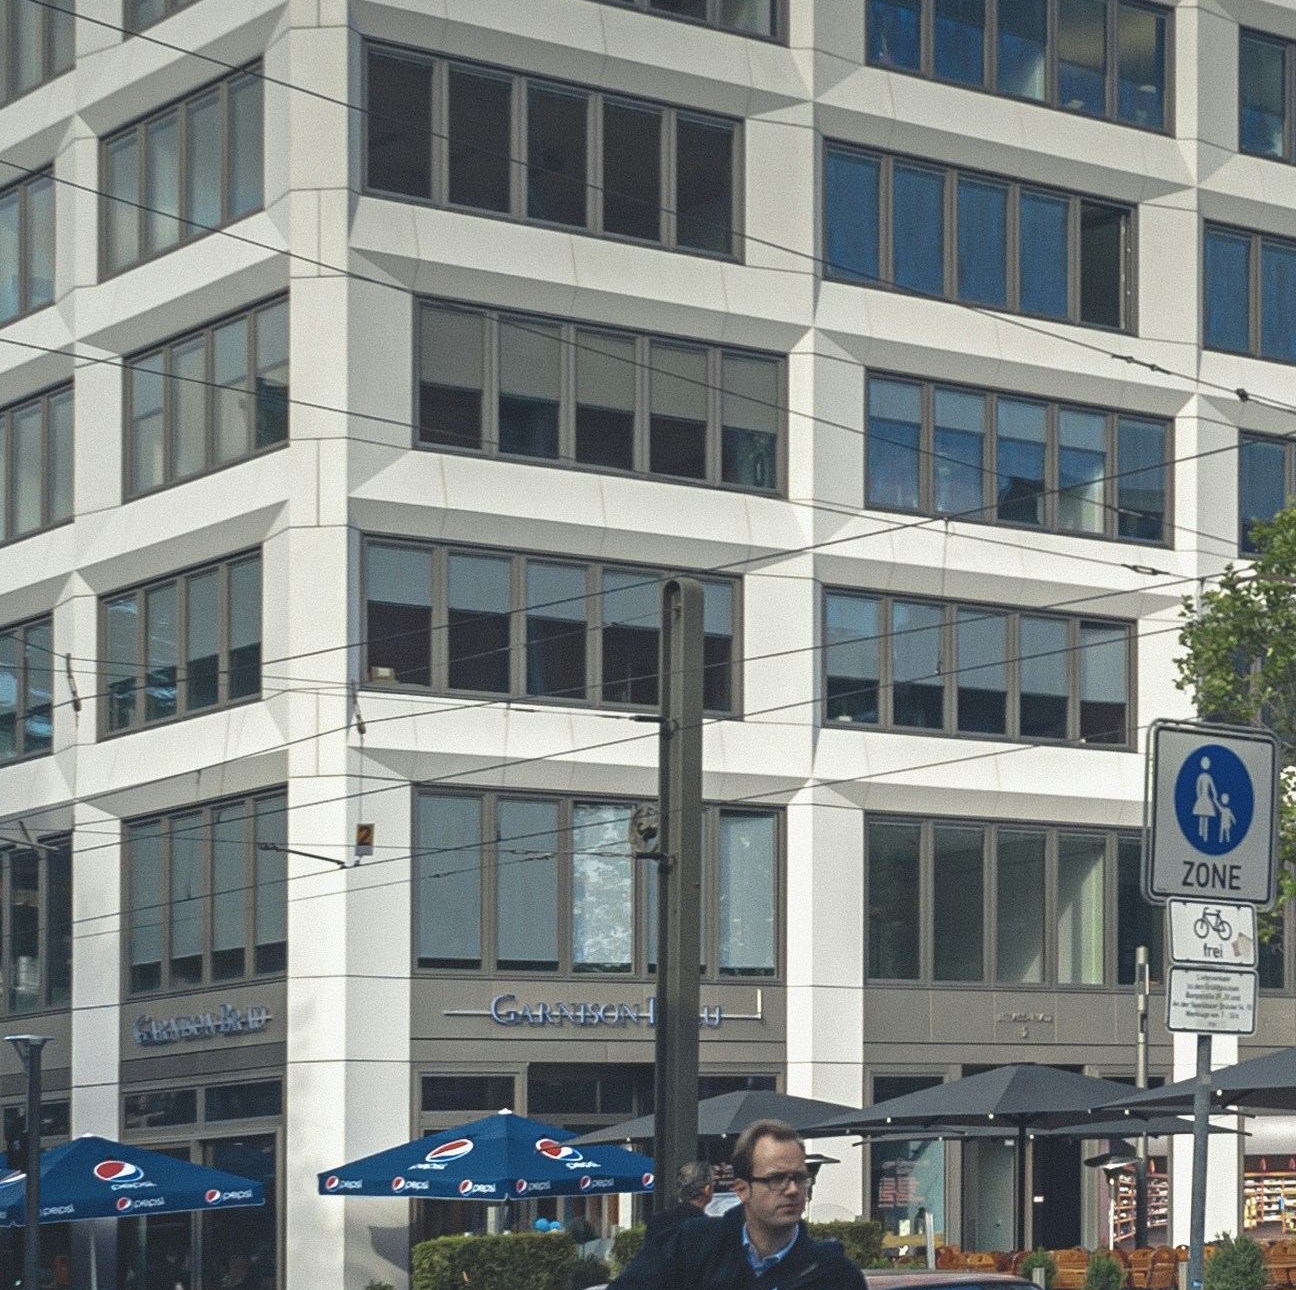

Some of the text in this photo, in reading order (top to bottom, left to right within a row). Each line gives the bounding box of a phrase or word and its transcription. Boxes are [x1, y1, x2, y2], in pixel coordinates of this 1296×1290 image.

[1181, 860, 1242, 891] ZONE
[1203, 942, 1223, 959] frei
[490, 993, 640, 1027] GARNISON
[338, 1179, 363, 1189] pepsi
[404, 1180, 429, 1191] pepsi
[472, 1183, 496, 1194] pepsi
[528, 1180, 551, 1191] pepsi
[591, 1178, 614, 1189] pepsi
[222, 1189, 254, 1201] pepsi
[133, 1196, 165, 1209] pepsi
[43, 1203, 75, 1216] pepsi
